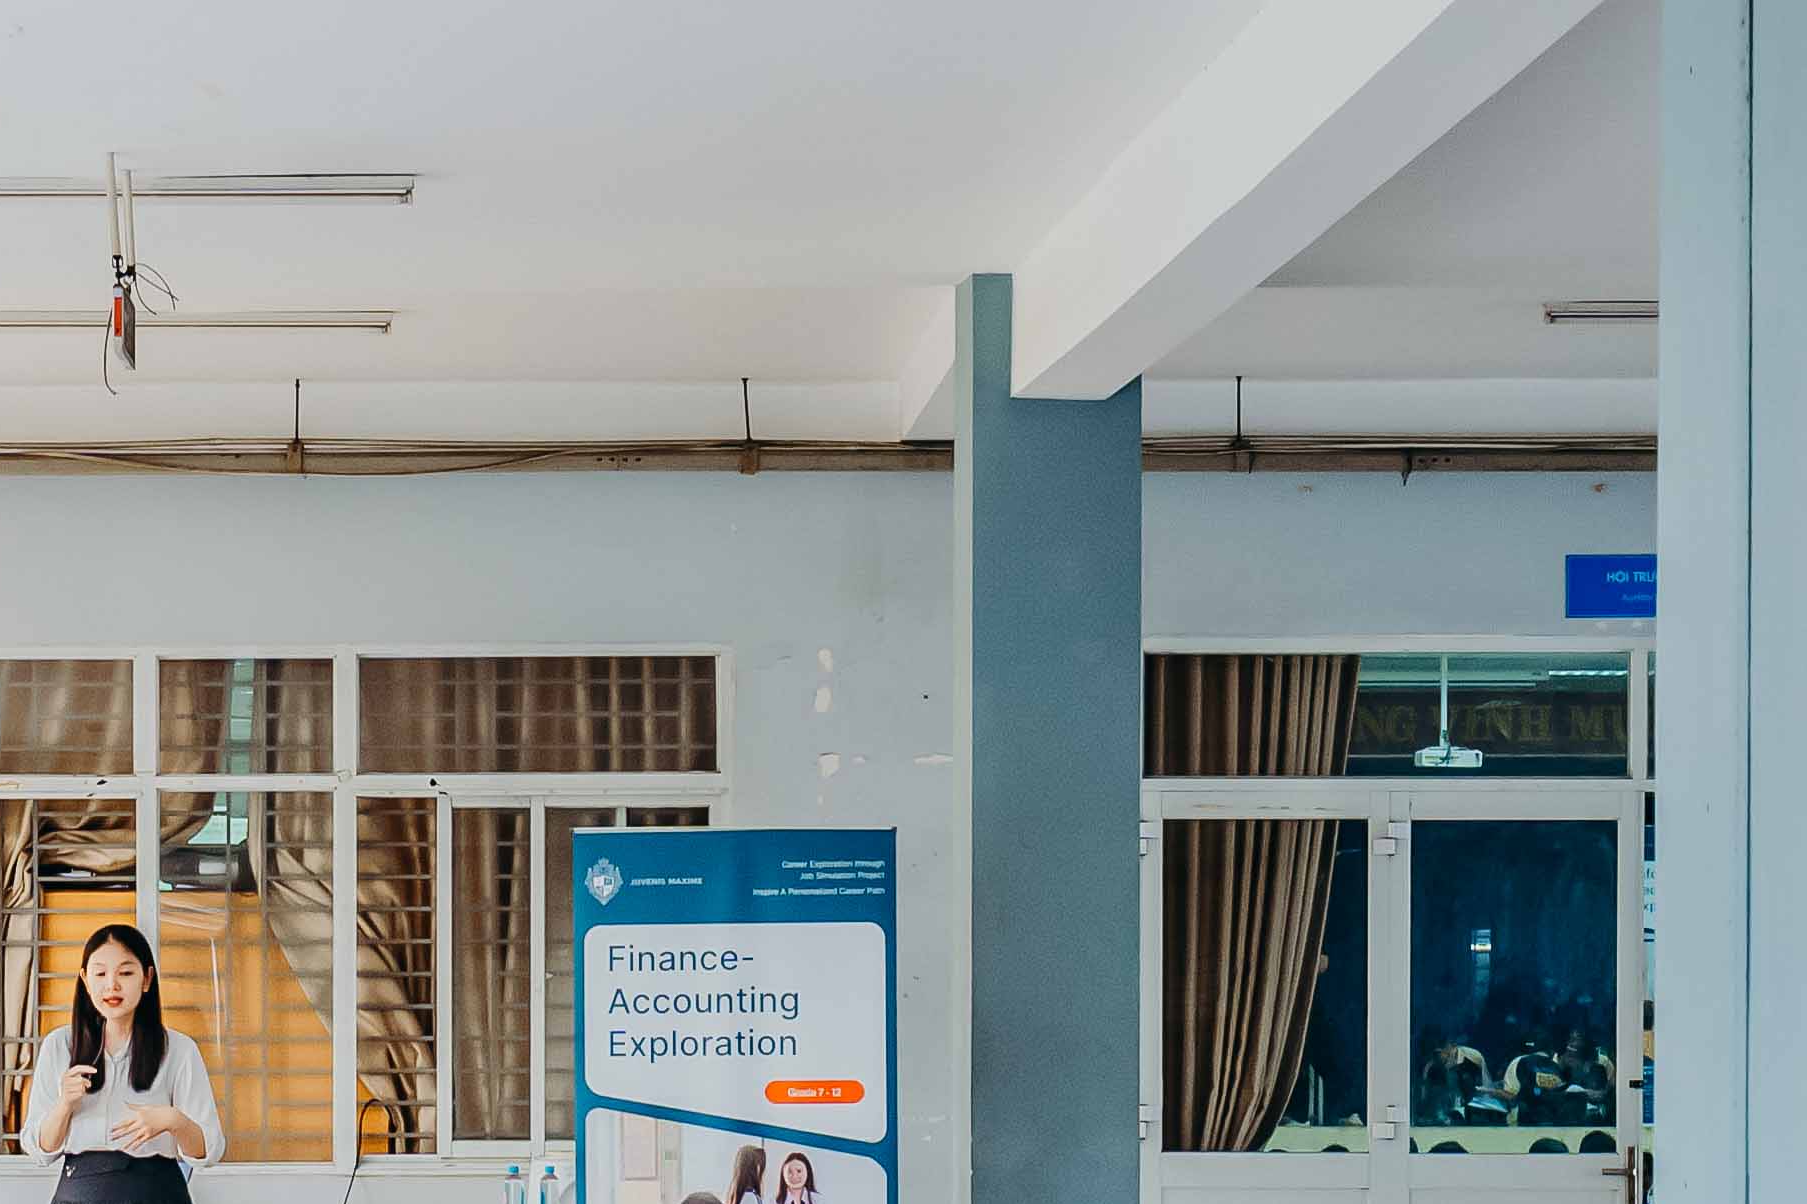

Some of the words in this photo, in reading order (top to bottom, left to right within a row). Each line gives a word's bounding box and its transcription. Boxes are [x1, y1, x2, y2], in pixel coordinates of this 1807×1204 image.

[608, 945, 755, 973] Finance-
[608, 986, 800, 1020] Accounting
[609, 1029, 798, 1063] Exploration
